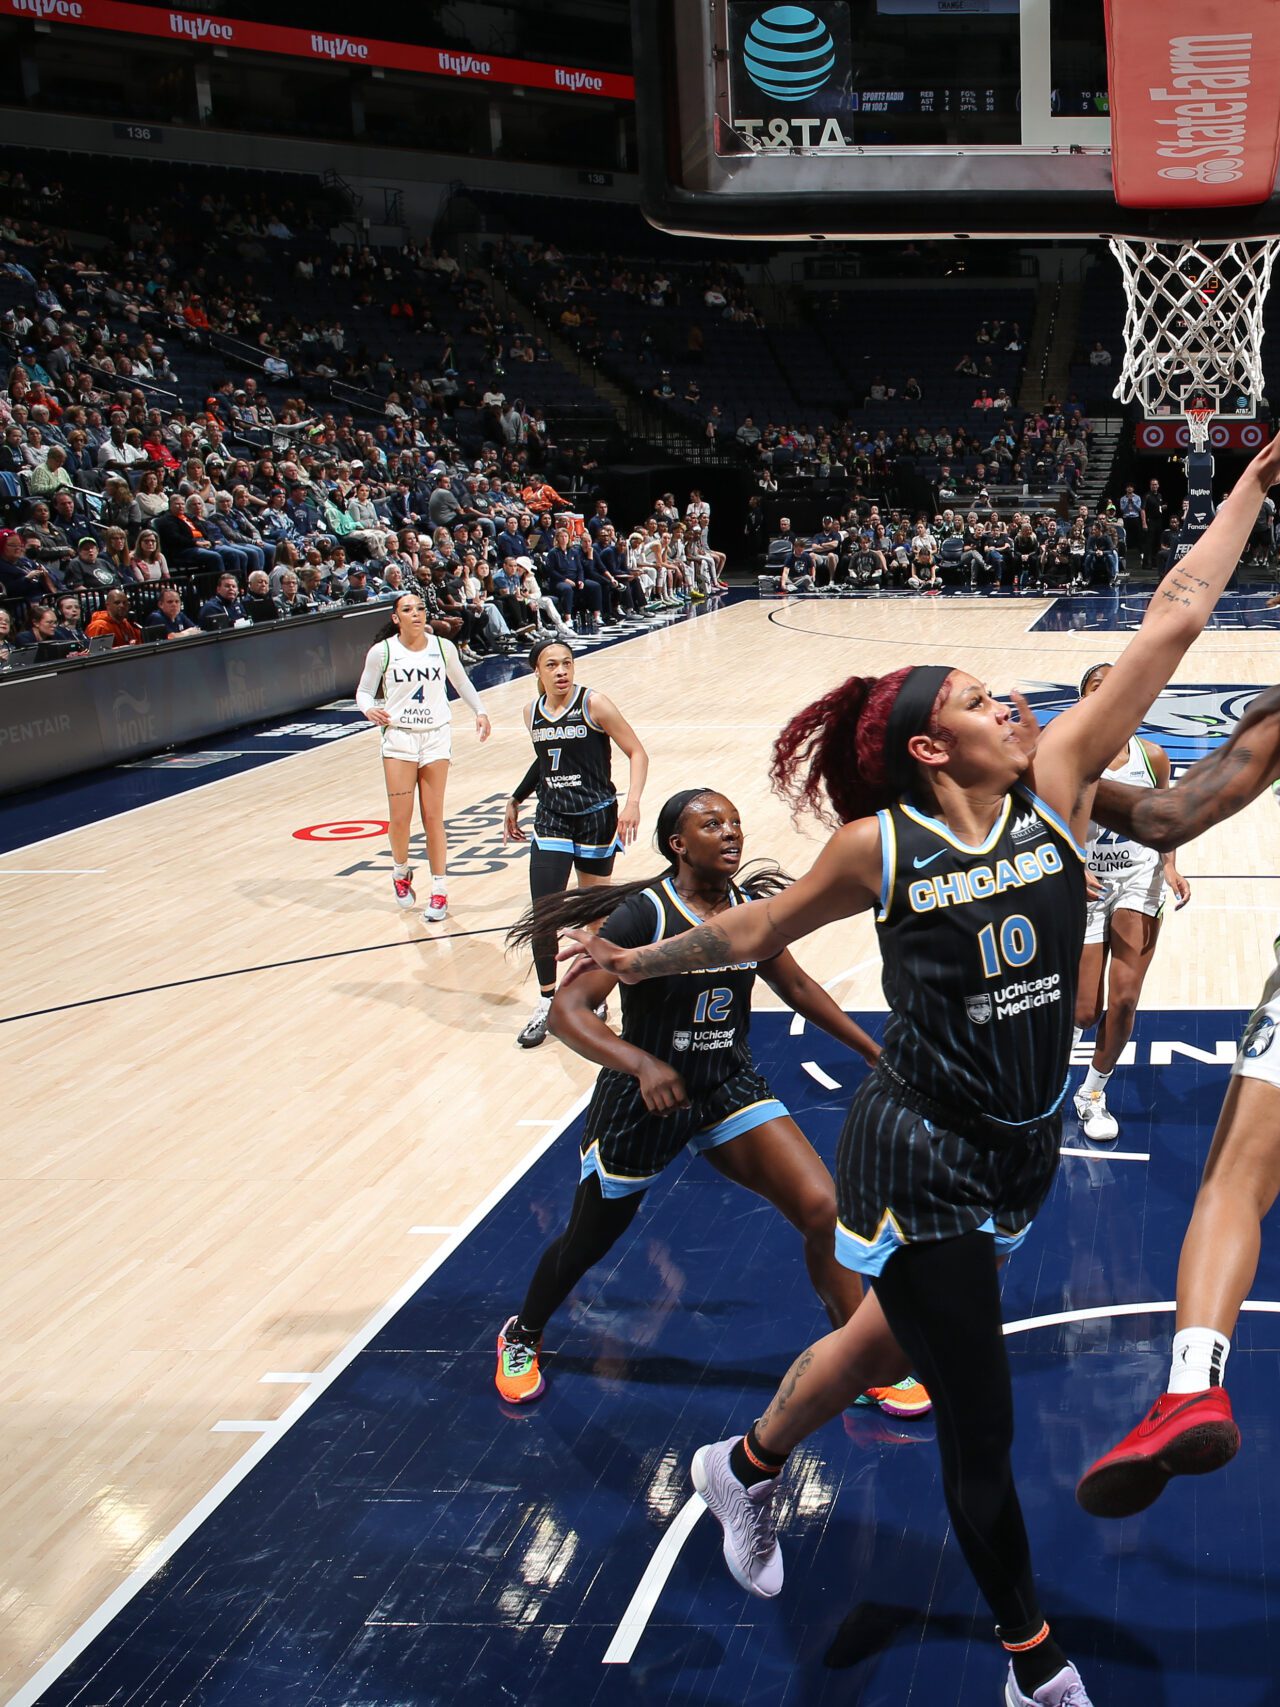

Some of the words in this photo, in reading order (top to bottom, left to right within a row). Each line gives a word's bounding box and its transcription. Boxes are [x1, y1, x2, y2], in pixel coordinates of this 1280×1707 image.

[862, 92, 885, 101] SPORTS
[886, 92, 904, 101] RADIO
[862, 103, 872, 111] FM
[872, 103, 888, 111] 100.3
[127, 127, 151, 139] 136
[393, 667, 441, 683] LYNX
[411, 685, 425, 704] 4
[0, 714, 71, 745] PENTAIR
[400, 716, 434, 724] CLINIC
[117, 715, 156, 749] MOVE
[547, 748, 562, 771] 7
[1092, 850, 1130, 860] MAYO
[1088, 860, 1133, 872] CLINIC
[908, 843, 1064, 913] CHICAGO
[977, 914, 1037, 979] 10
[994, 973, 1061, 1003] UChicago
[693, 987, 734, 1023] 12
[997, 988, 1062, 1020] Medicine
